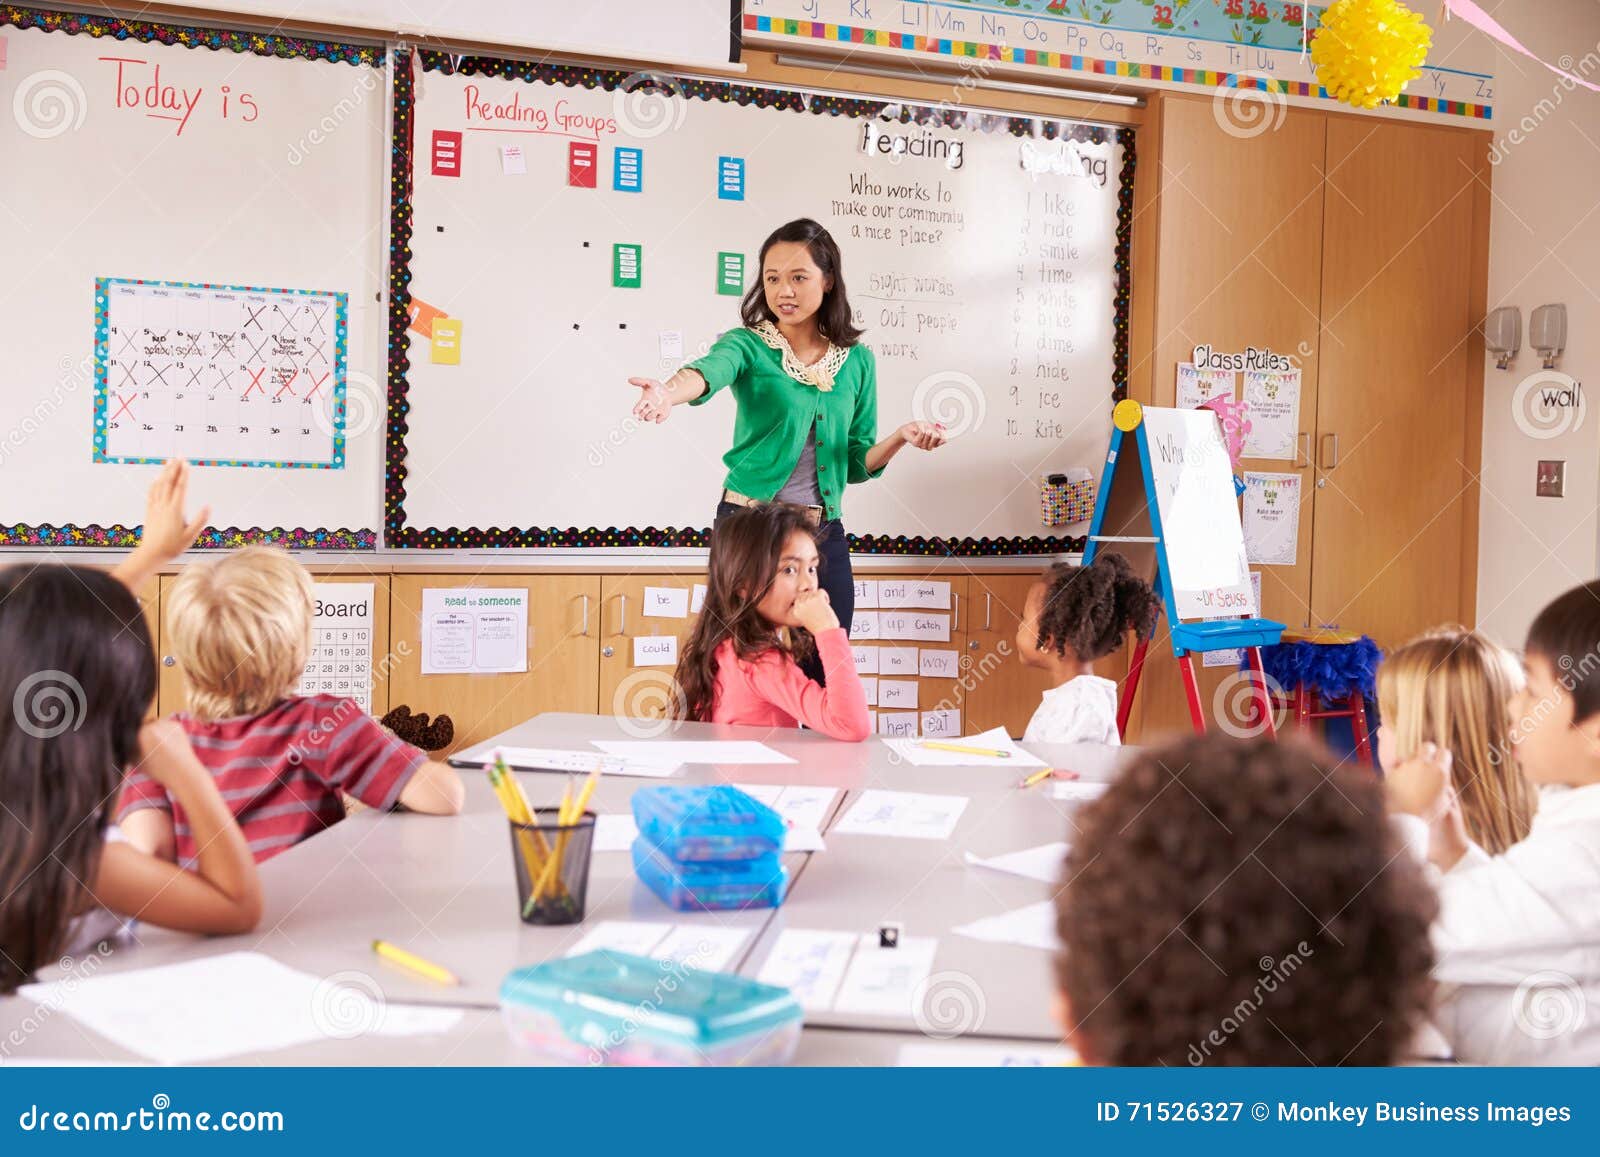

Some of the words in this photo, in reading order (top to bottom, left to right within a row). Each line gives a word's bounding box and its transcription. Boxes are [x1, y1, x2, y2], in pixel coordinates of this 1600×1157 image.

[1154, 4, 1173, 22] 32
[1249, 2, 1268, 19] 36
[1284, 4, 1302, 22] 38
[850, 0, 872, 19] Kk
[935, 11, 965, 32] Mm
[981, 15, 1006, 37] Nn
[1023, 21, 1048, 42] Oo
[1066, 27, 1088, 52] Pp
[1100, 31, 1127, 59] Qq
[1146, 36, 1163, 56] Rr
[1187, 41, 1202, 61] Ss
[1226, 46, 1241, 65] Tt
[1256, 52, 1275, 71] Uu
[1431, 74, 1447, 96] Yy
[1474, 79, 1493, 98] Zz
[98, 57, 202, 136] Today
[221, 86, 258, 122] is
[464, 85, 549, 131] Reading
[554, 100, 617, 139] Groups
[850, 172, 882, 196] Who
[887, 182, 930, 201] works
[832, 200, 867, 217] make
[872, 204, 894, 218] our
[1043, 191, 1075, 216] like
[851, 225, 860, 238] a
[865, 227, 892, 240] nice
[900, 226, 943, 246] place?
[1040, 242, 1079, 261] smile
[1038, 261, 1073, 283] time
[111, 327, 118, 335] 4
[143, 328, 150, 336] 5
[881, 343, 919, 361] work
[1196, 346, 1243, 370] Class
[1246, 348, 1289, 371] Rules
[176, 361, 185, 369] 13
[1035, 353, 1069, 381] hide
[1039, 387, 1061, 409] ice
[1541, 382, 1581, 408] wall
[1035, 417, 1065, 439] kite
[884, 584, 905, 598] and
[1216, 588, 1247, 607] Seuss
[445, 597, 467, 607] Read
[478, 597, 521, 606] someone
[657, 594, 671, 605] be
[887, 618, 905, 633] up
[326, 632, 332, 640] 8
[342, 632, 348, 641] 9
[357, 632, 366, 640] 10
[324, 648, 333, 656] 18
[340, 648, 350, 657] 19
[355, 648, 366, 656] 20
[642, 643, 670, 653] could
[891, 657, 902, 665] no
[923, 657, 949, 673] way
[322, 665, 333, 673] 28
[339, 665, 349, 673] 29
[354, 665, 365, 673] 30
[306, 682, 316, 690] 37
[322, 682, 333, 690] 38
[338, 682, 349, 690] 39
[886, 688, 901, 699] put
[886, 716, 912, 737] her
[928, 712, 949, 732] eat
